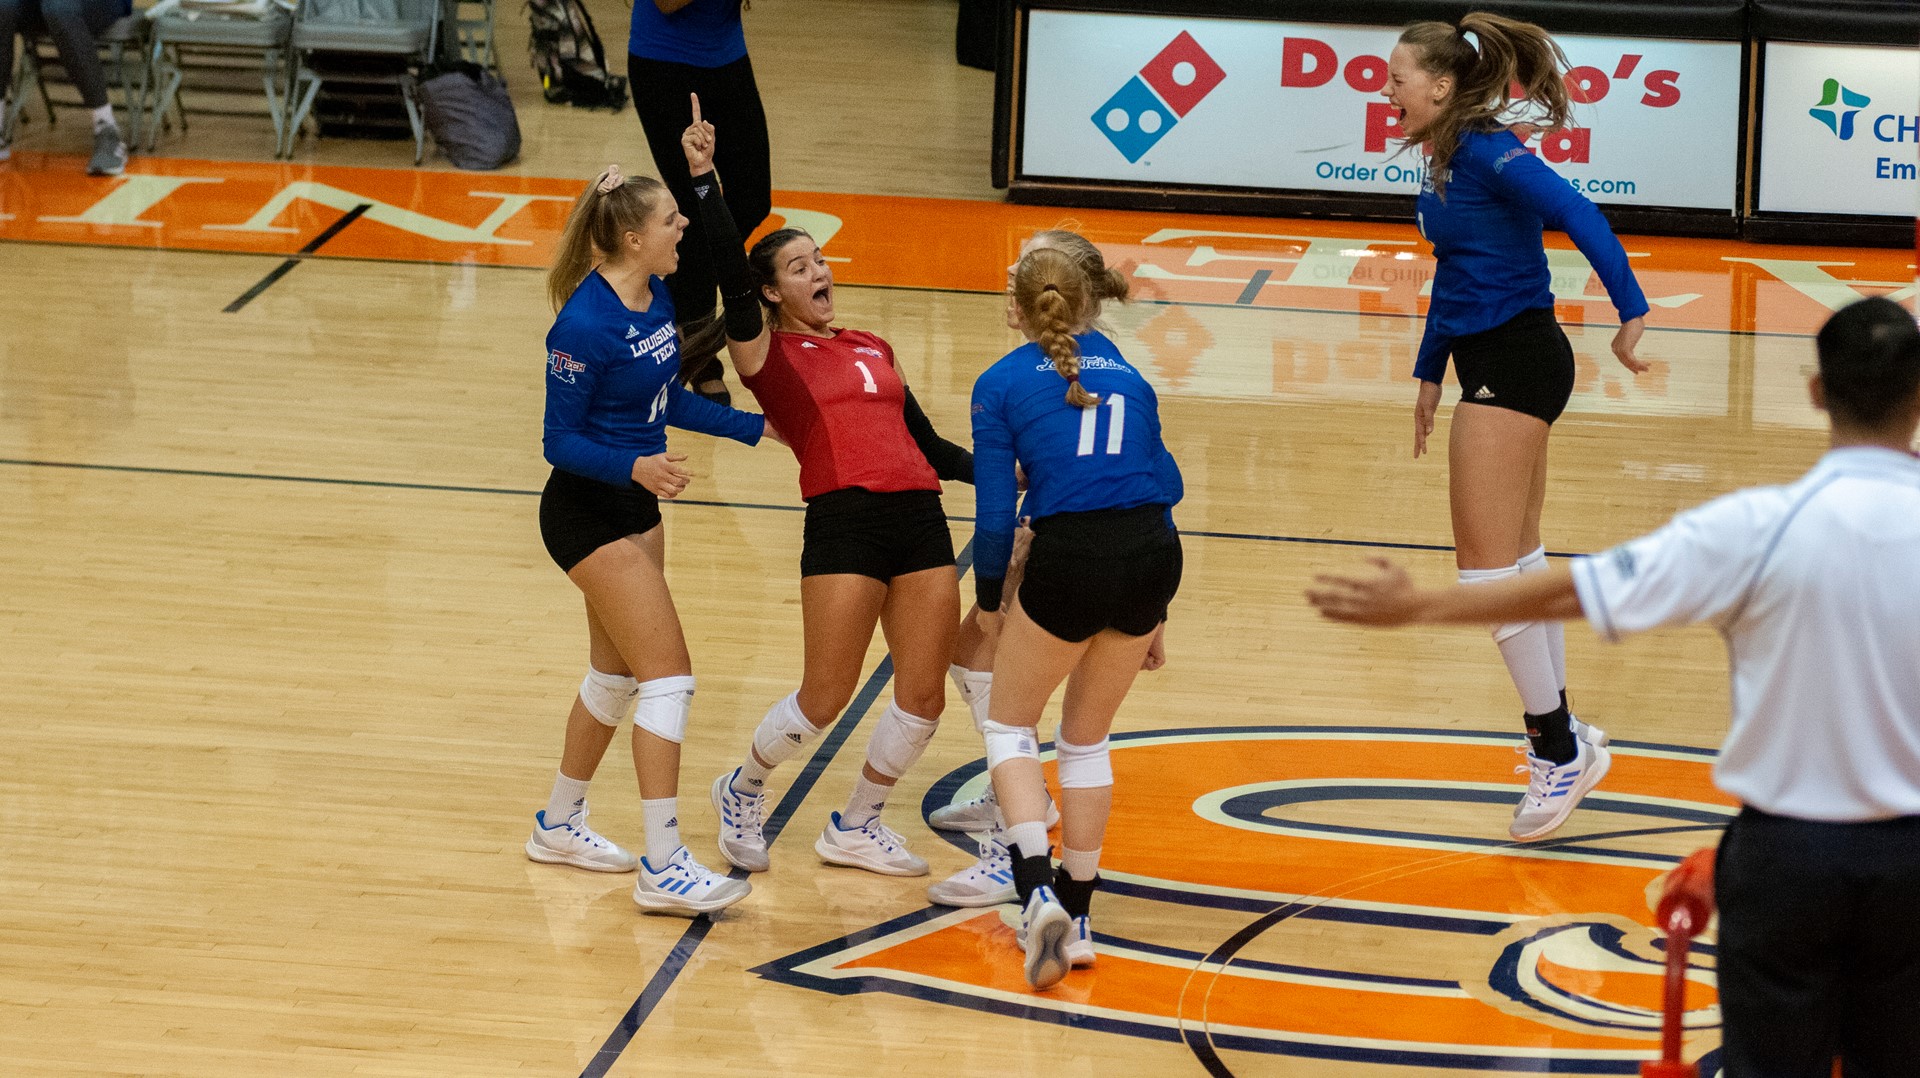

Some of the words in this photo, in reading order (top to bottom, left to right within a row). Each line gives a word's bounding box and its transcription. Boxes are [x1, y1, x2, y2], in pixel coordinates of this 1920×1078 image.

[1280, 36, 1682, 108] Doo's
[1316, 161, 1378, 181] Order
[1383, 164, 1422, 184] Onl
[629, 320, 677, 358] LOUISIAN
[651, 340, 677, 365] TECH
[854, 360, 878, 393] 1
[1076, 392, 1125, 456] 11
